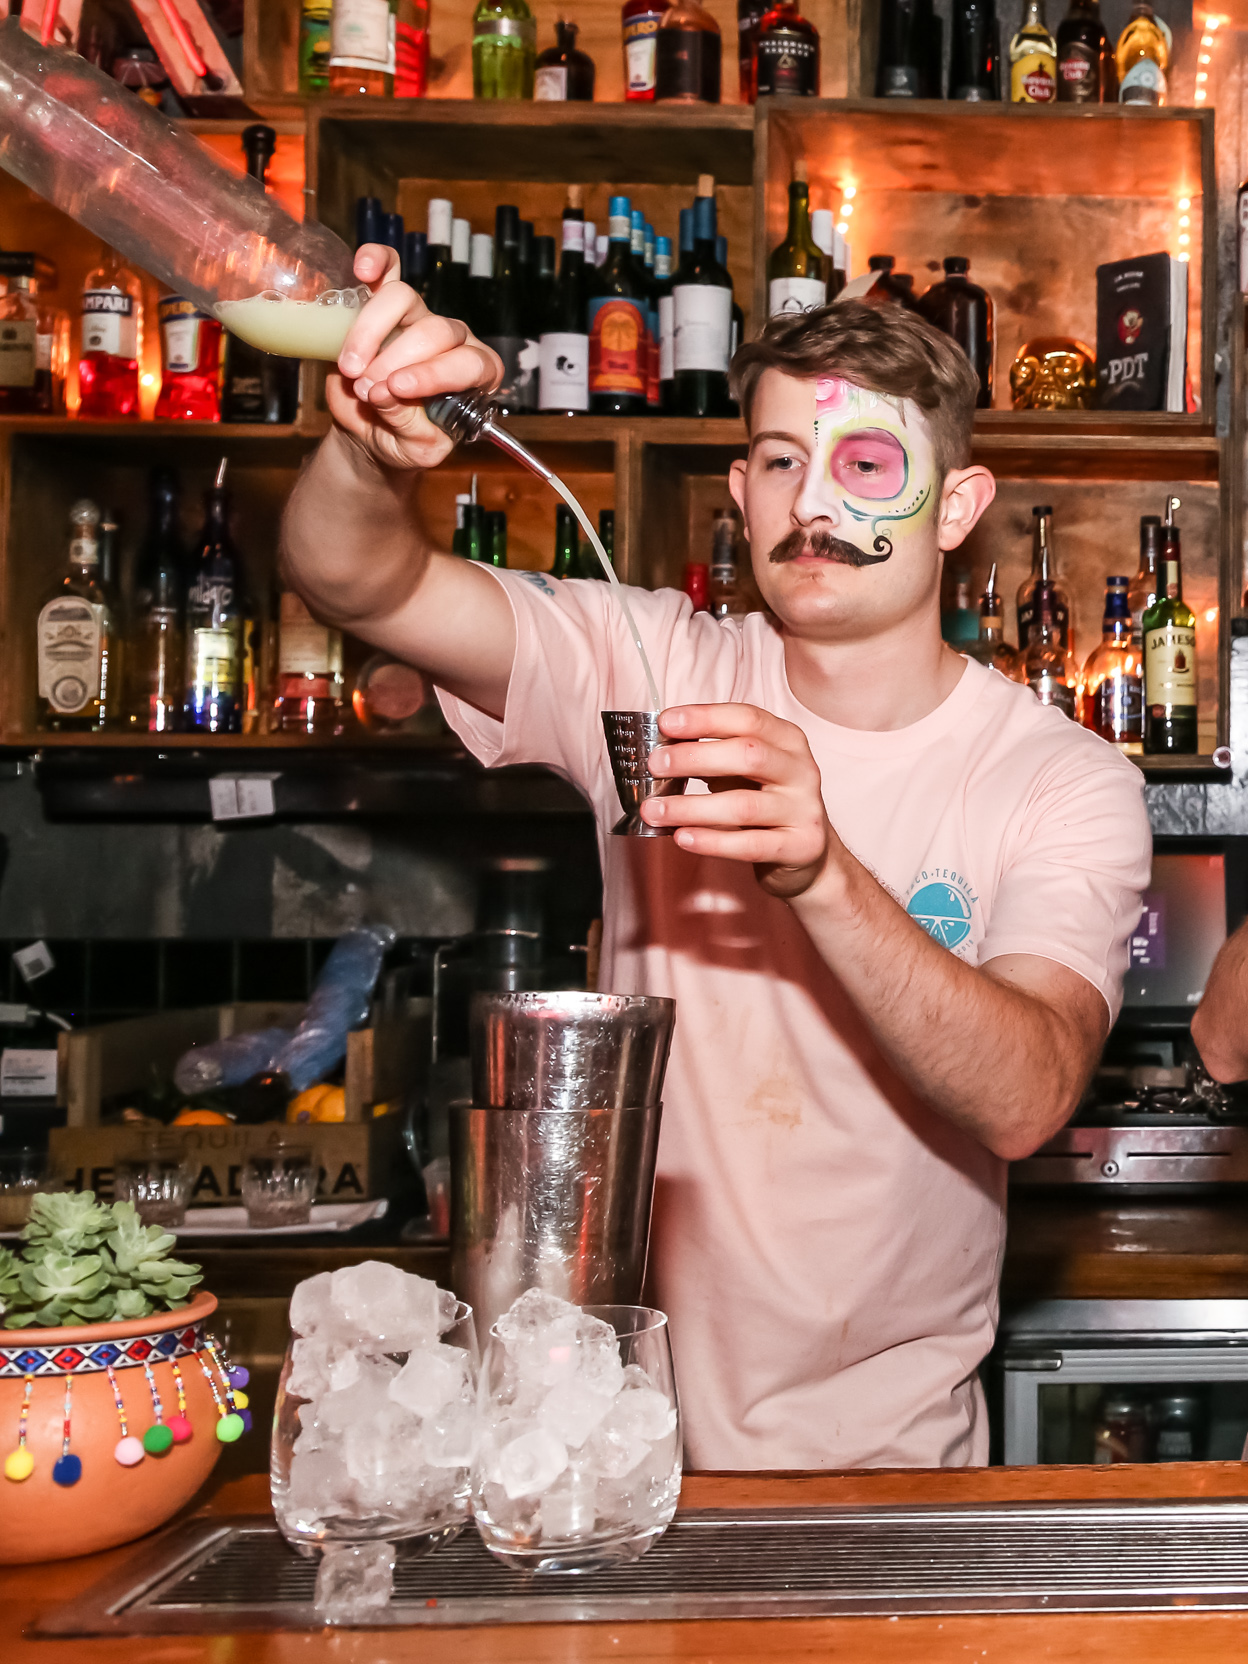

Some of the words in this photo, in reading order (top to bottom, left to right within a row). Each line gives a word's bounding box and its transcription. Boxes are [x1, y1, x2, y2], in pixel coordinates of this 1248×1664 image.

[84, 296, 129, 310] MPARI
[1151, 634, 1195, 650] JAMESO
[935, 868, 979, 904] TEQUILA
